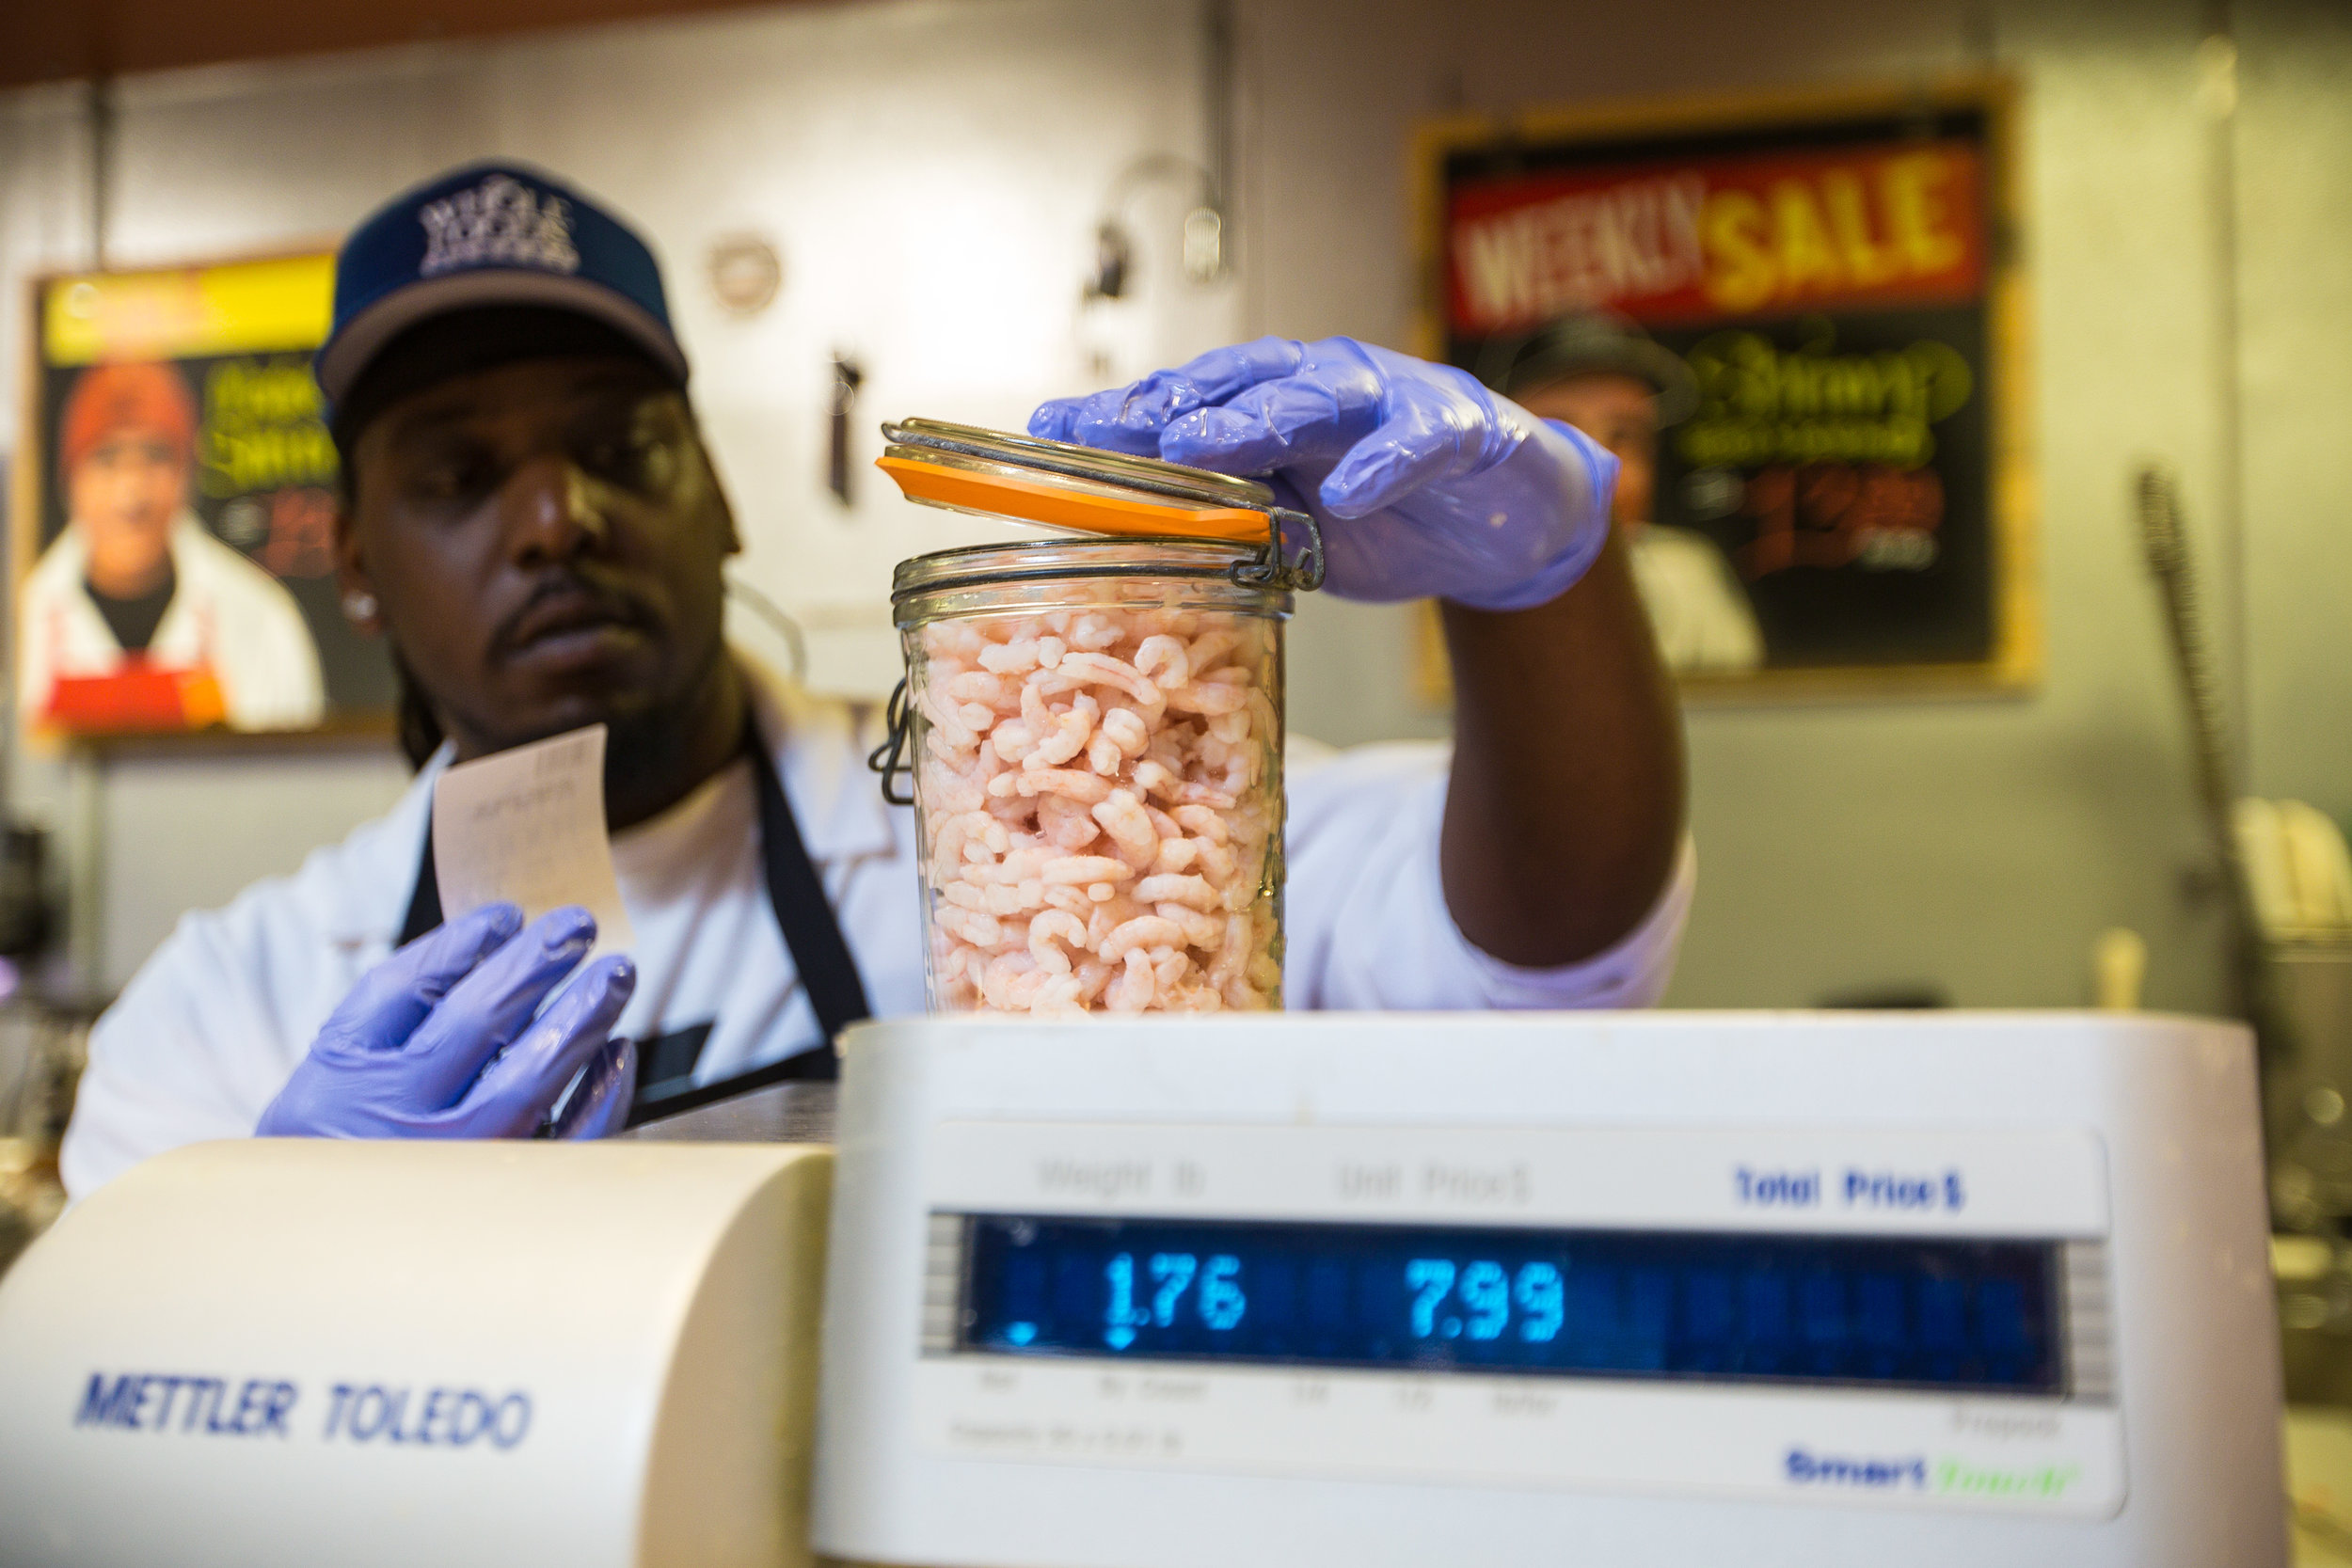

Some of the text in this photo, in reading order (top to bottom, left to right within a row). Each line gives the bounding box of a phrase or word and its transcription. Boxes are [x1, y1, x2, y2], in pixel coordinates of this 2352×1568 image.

[1458, 150, 1966, 322] WEEKLY SALE
[1735, 1166, 1822, 1209] Total
[1406, 1258, 1565, 1343] 7.99
[73, 1370, 534, 1451] METTLER TOLEDO
